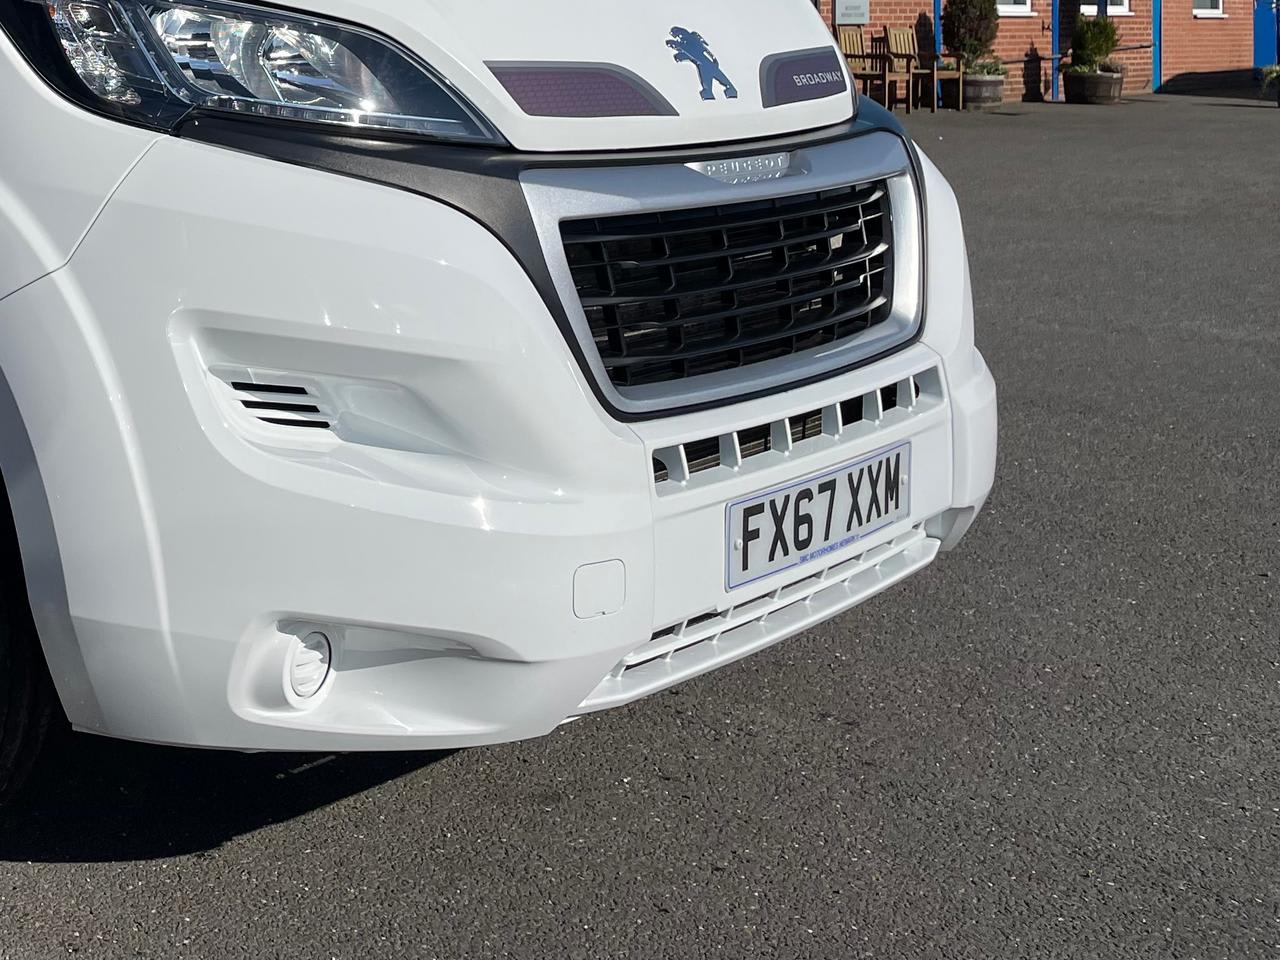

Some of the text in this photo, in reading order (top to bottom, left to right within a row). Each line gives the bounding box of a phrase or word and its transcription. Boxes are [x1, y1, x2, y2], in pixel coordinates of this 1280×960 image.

[792, 71, 843, 87] BROADWAY
[742, 453, 901, 571] FX67 XXM
